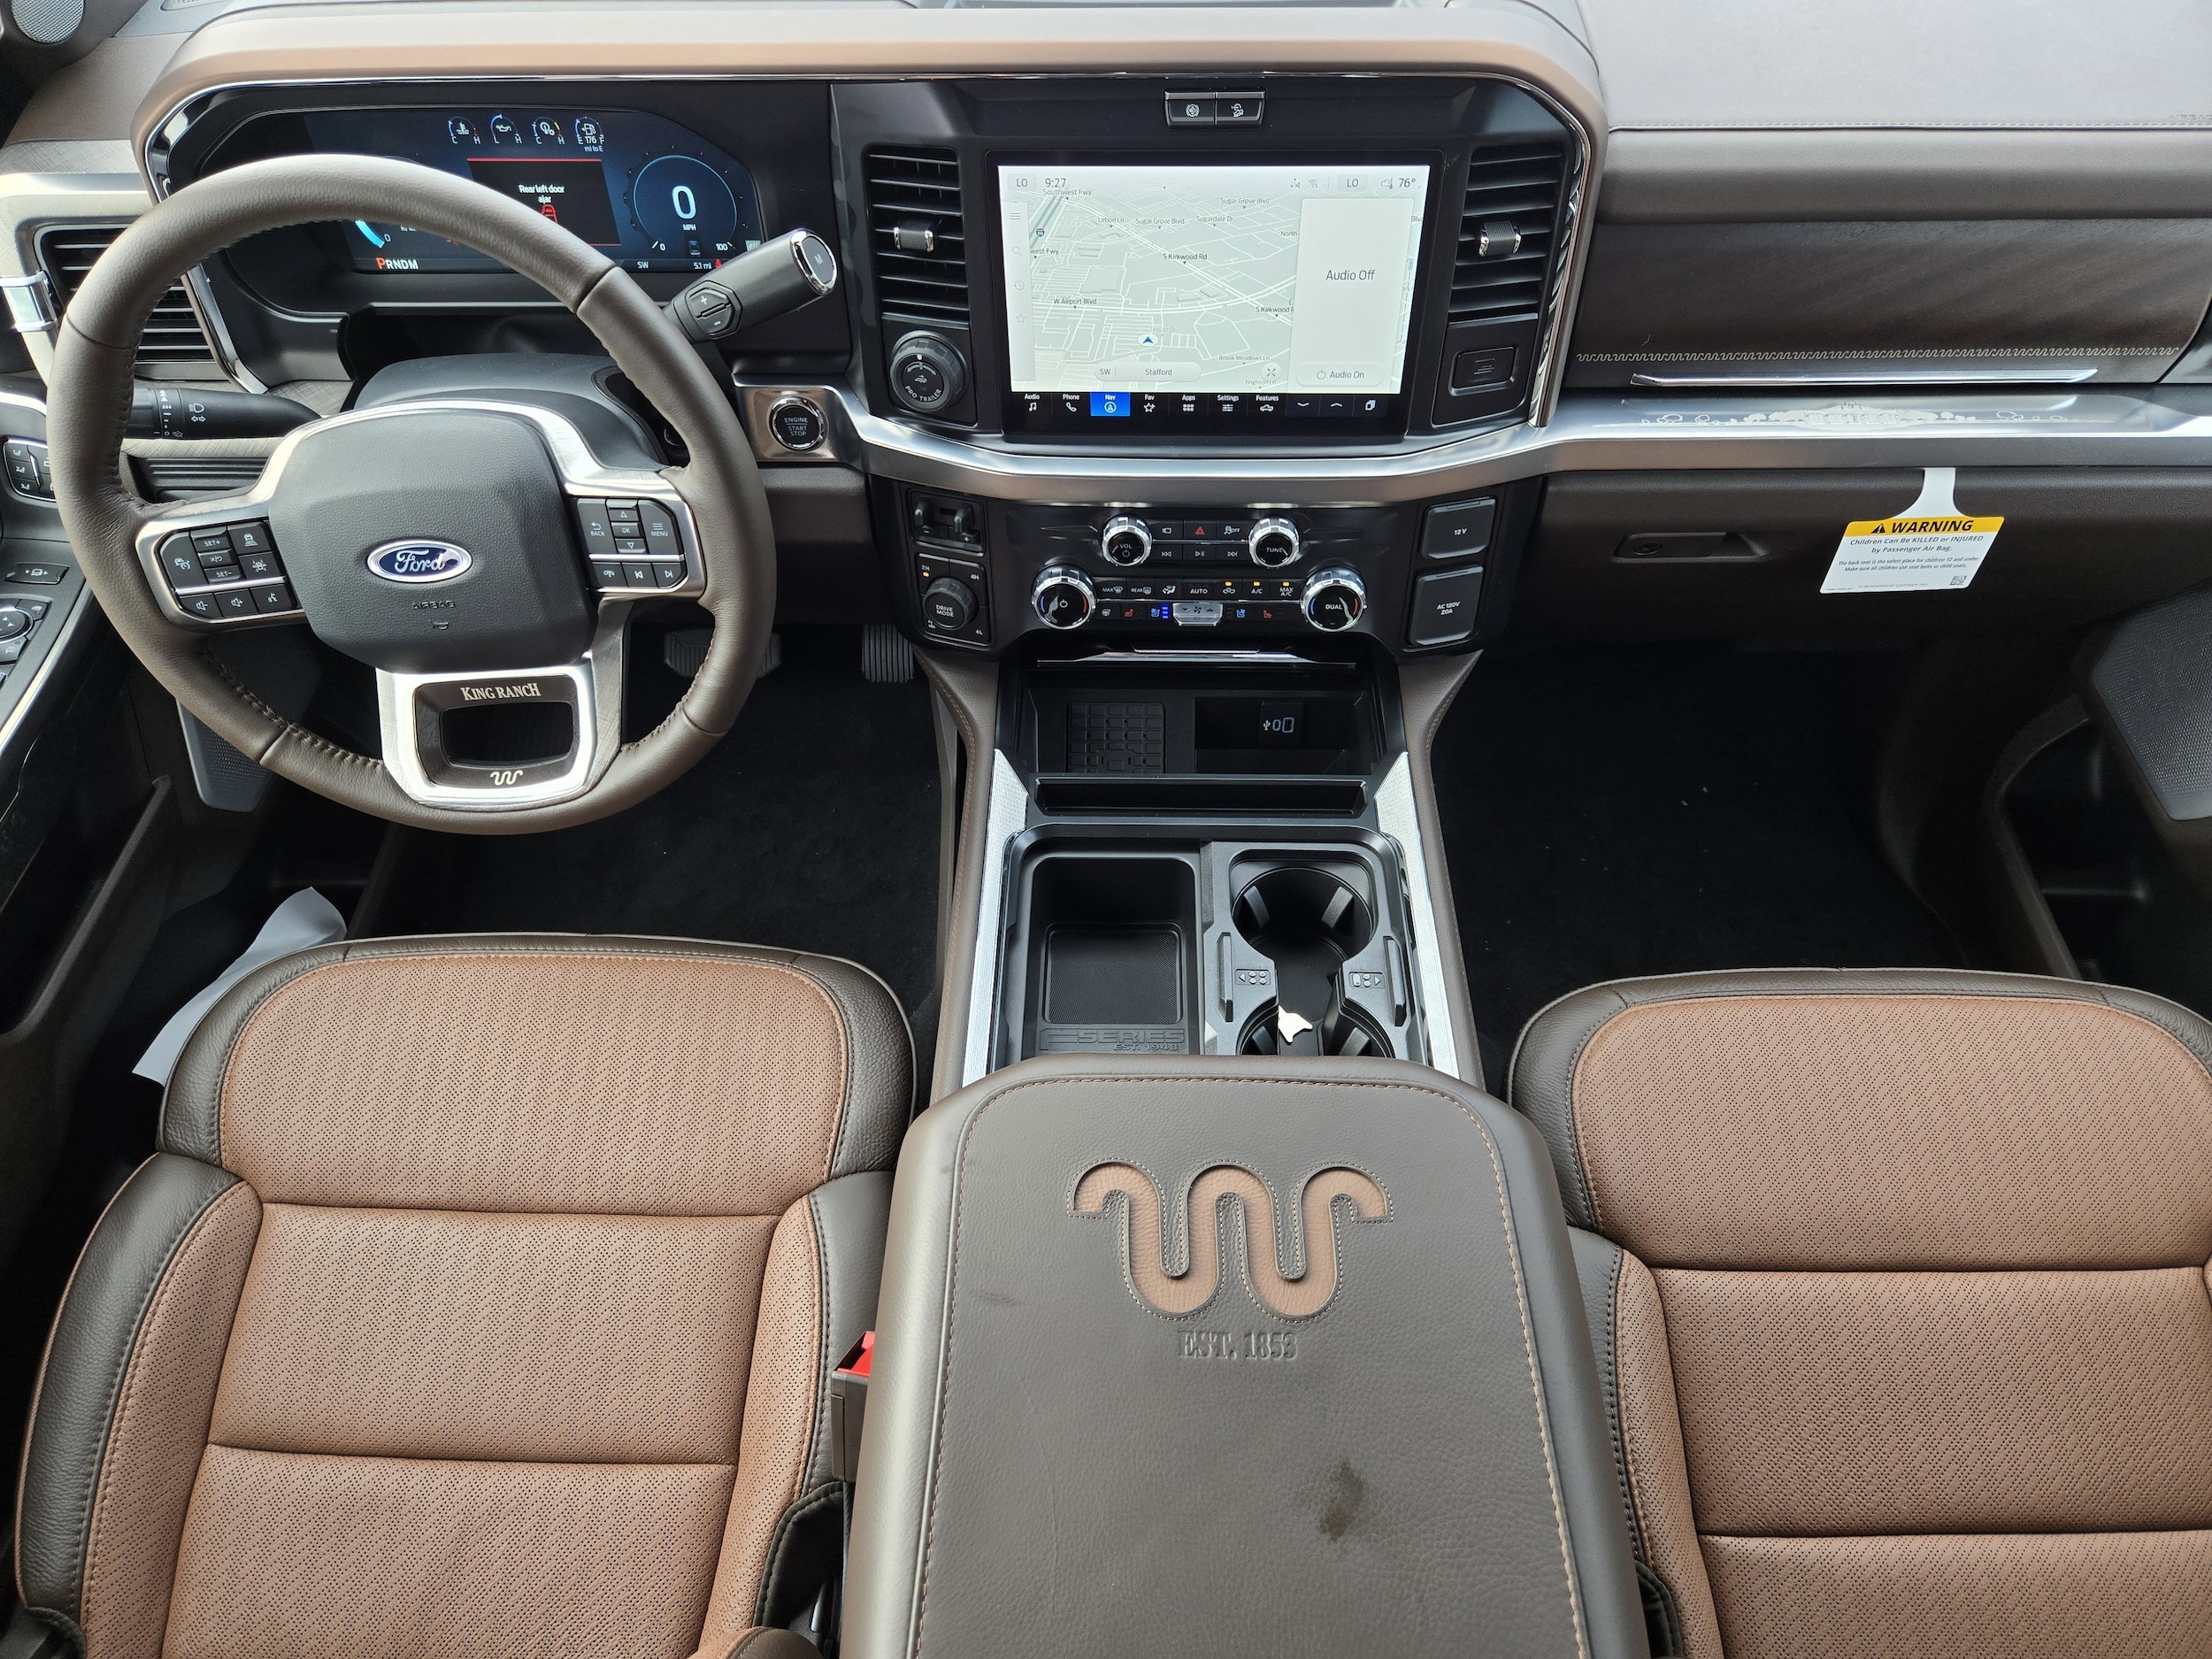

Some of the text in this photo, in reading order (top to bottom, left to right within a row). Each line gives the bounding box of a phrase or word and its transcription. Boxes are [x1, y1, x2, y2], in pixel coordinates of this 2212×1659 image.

[585, 135, 597, 144] 176
[1017, 178, 1028, 188] LO
[1045, 177, 1066, 188] 9:27
[1347, 178, 1359, 188] LO
[1399, 177, 1417, 188] 76°
[518, 184, 565, 193] Rear left door
[538, 195, 552, 204] ajar
[672, 185, 696, 219] 0
[383, 234, 392, 242] 0
[1325, 269, 1376, 280] Audio Off
[905, 386, 941, 403] PRO TRAILER
[1892, 520, 1975, 534] WARNING
[394, 549, 446, 573] Ford
[412, 600, 455, 611] AIRBAG
[460, 683, 541, 701] KING RANCH
[1177, 1330, 1298, 1362] EST. 1853
